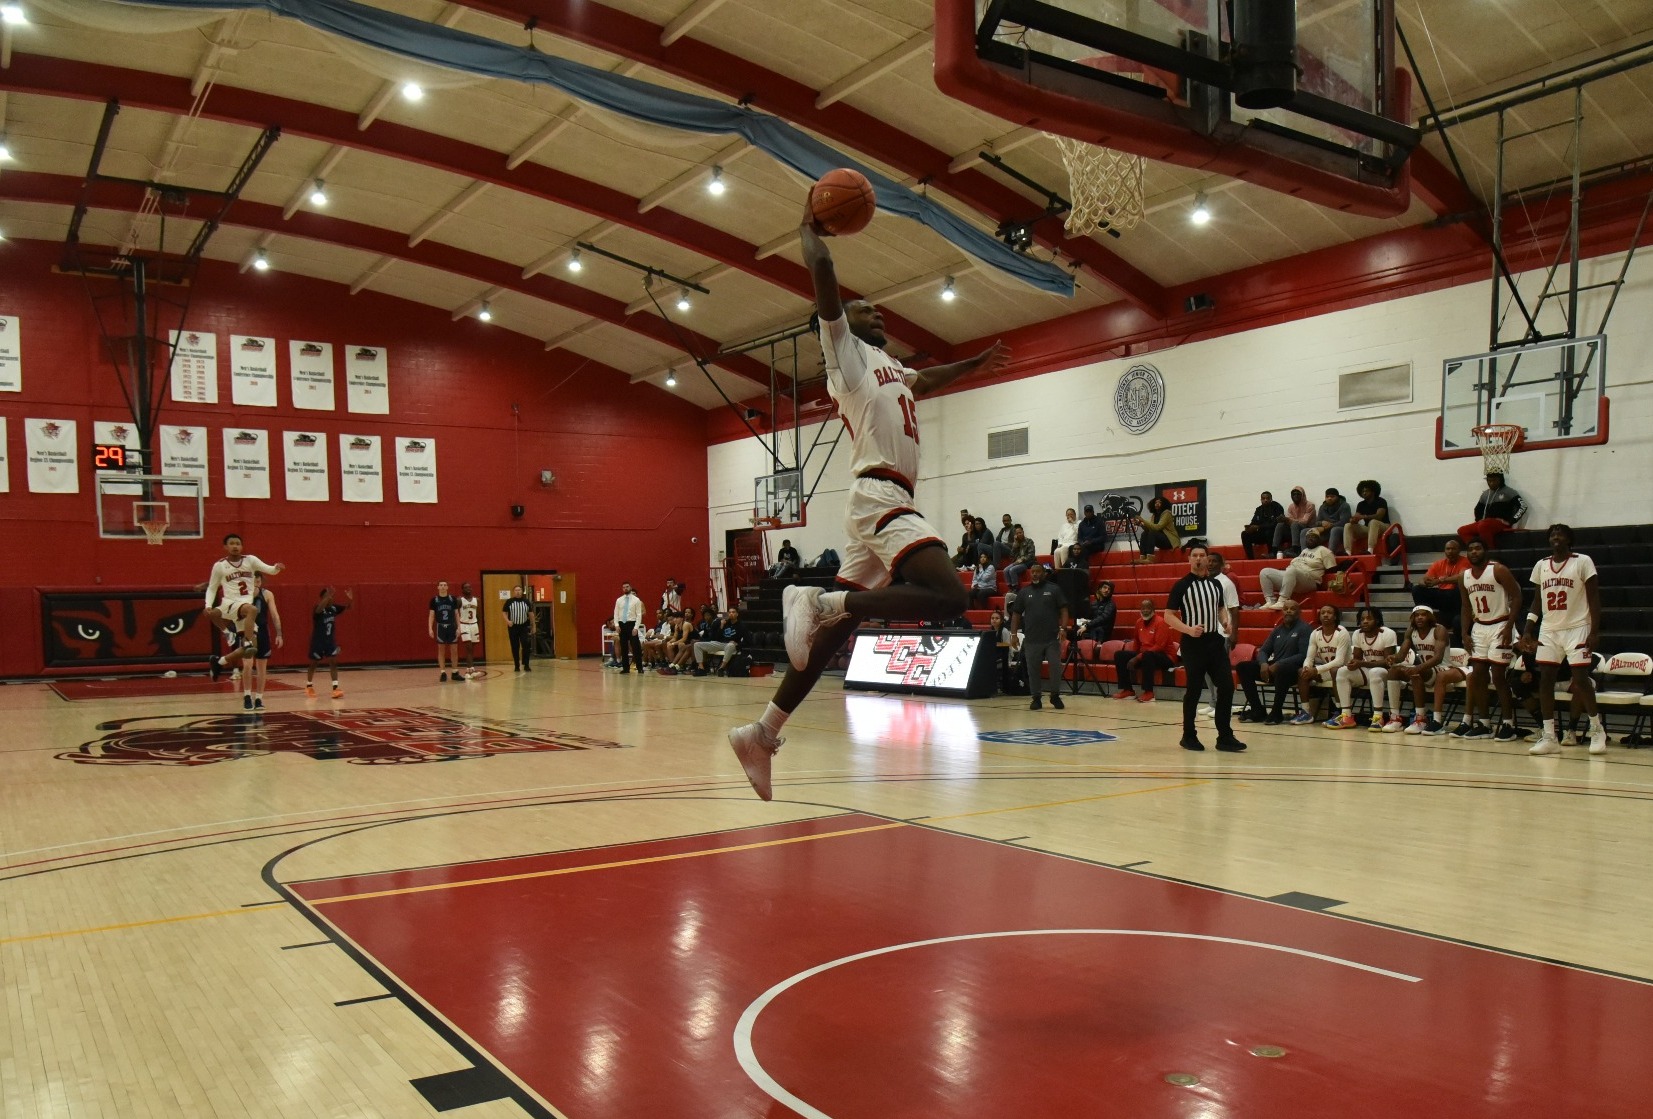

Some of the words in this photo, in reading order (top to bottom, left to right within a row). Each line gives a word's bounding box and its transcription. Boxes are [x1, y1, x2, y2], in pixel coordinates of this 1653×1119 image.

[95, 446, 123, 467] 29
[1171, 502, 1199, 516] OTECT
[238, 581, 248, 595] 2
[1475, 596, 1490, 613] 11
[1546, 591, 1567, 611] 22
[442, 611, 448, 620] 2
[468, 610, 473, 619] 3
[326, 623, 332, 635] 3
[1610, 658, 1649, 672] BALTIMORE
